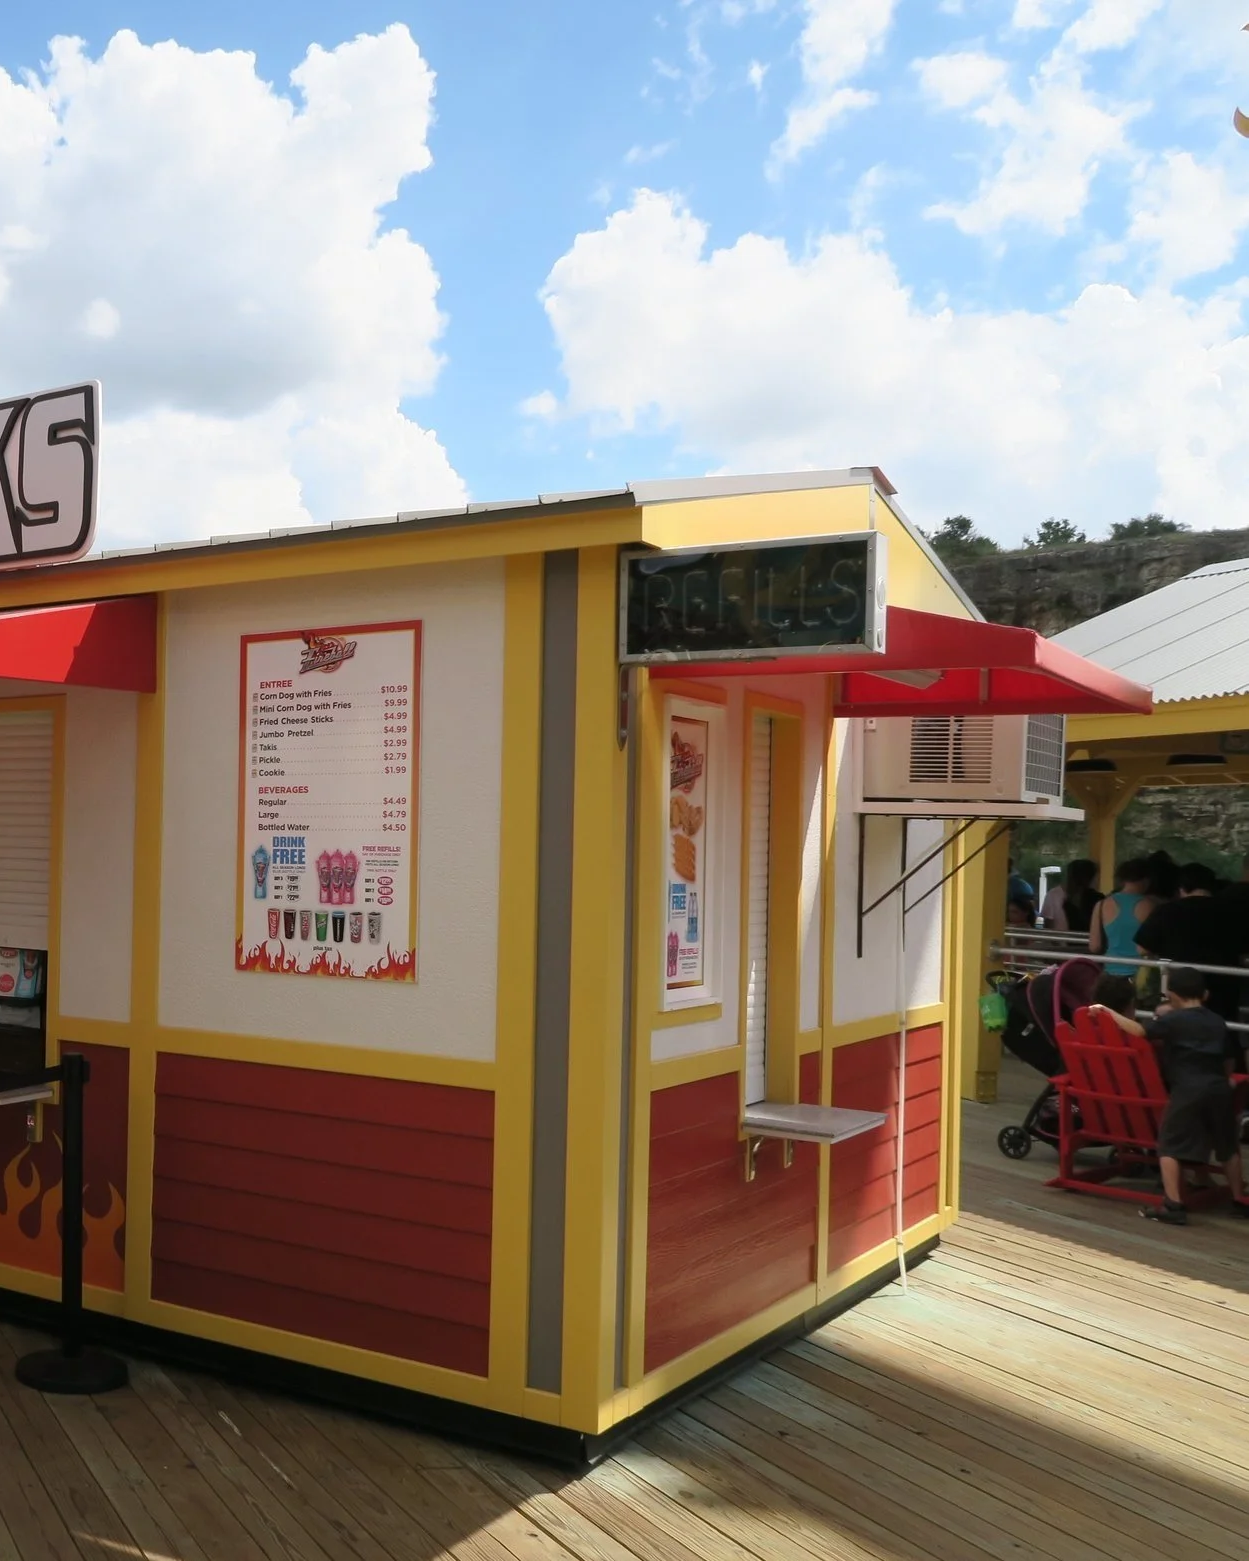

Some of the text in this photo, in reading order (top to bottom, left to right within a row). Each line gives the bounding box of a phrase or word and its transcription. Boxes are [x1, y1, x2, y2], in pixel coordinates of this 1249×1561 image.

[260, 680, 293, 689] ENTREE
[260, 685, 408, 701] Corn Dog with Fries $10.99
[297, 704, 312, 712] Dog
[333, 702, 351, 710] Fries
[384, 698, 408, 707] $9.99
[259, 712, 407, 726] Fried Cheese Sticks $4.99
[259, 726, 407, 739] Jumbo Pretzel $4.99
[259, 739, 407, 751] Takis $2.99
[259, 753, 407, 764] Pickle $2.79
[259, 766, 407, 777] Cookie $1.99
[258, 786, 309, 795] BEVERAGES
[258, 797, 407, 807] Regular $4.49
[258, 811, 407, 820] Large $4.79
[258, 823, 406, 832] Bottled Water $4.50
[272, 836, 306, 848] DRINK
[272, 849, 306, 864] FREE
